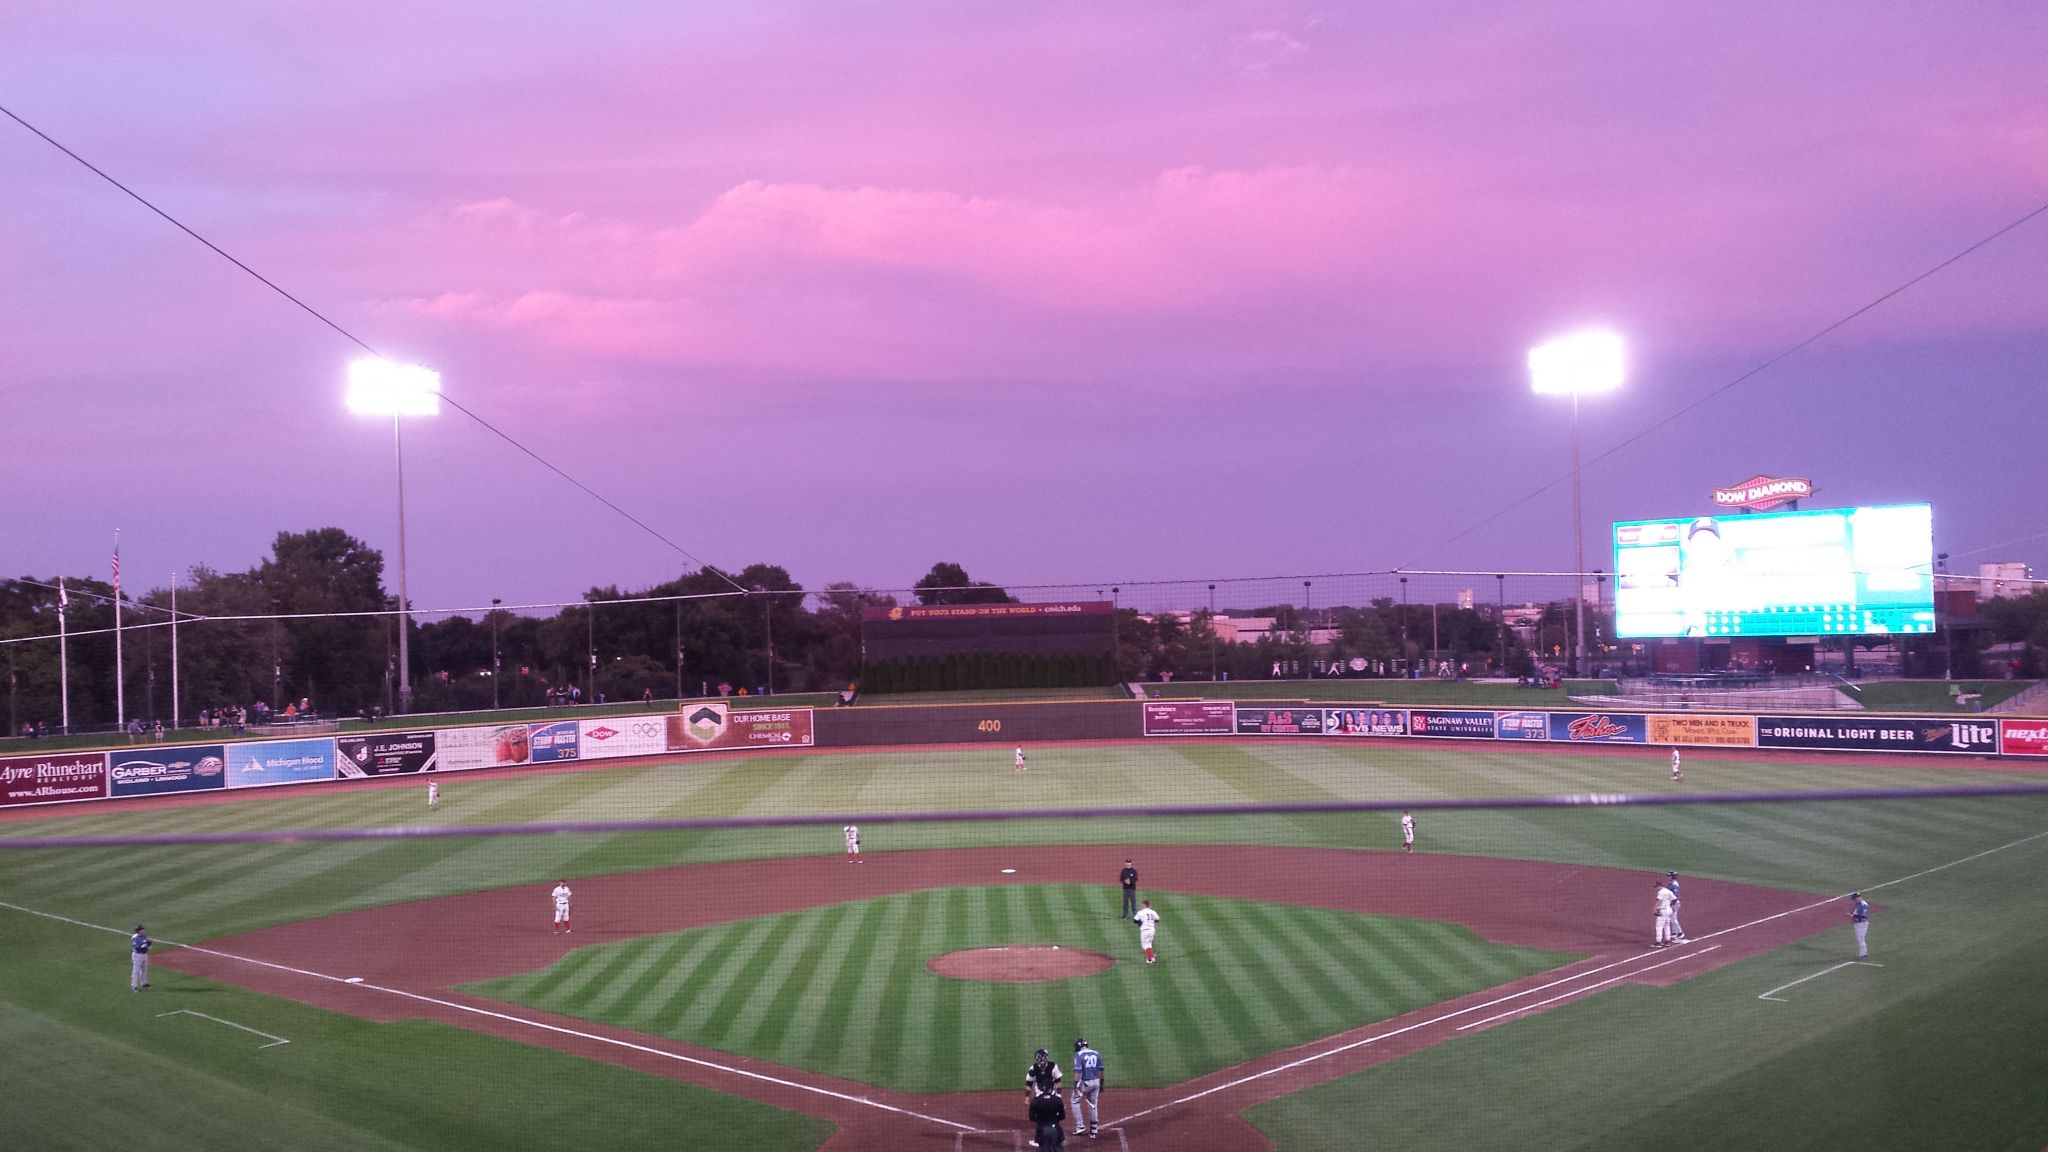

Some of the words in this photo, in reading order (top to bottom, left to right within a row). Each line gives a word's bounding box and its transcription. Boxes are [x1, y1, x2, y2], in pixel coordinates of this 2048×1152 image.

[1717, 491, 1746, 503] DOW
[1749, 482, 1807, 500] DIAMOND
[951, 608, 976, 616] STAMP
[991, 607, 1007, 615] THE
[1044, 605, 1081, 614] cmich.edu
[733, 714, 749, 723] OUR
[750, 714, 771, 722] HOME
[772, 713, 791, 721] BASE
[1267, 711, 1293, 725] A&S
[1427, 716, 1463, 725] SAGINAW
[1464, 718, 1494, 726] VALLEY
[978, 719, 1001, 731] 400
[1371, 725, 1404, 733] NEWS
[1568, 714, 1628, 740] Fisher
[592, 730, 614, 738] DOW
[749, 732, 781, 740] CHEMICAL
[1525, 729, 1545, 738] 373
[1774, 728, 1834, 738] ORIGINAL
[1838, 729, 1876, 739] LIGHT
[1880, 730, 1914, 740] BEER
[1950, 723, 1993, 748] Lite
[374, 744, 387, 752] J.E.
[388, 742, 423, 751] JOHNSON
[558, 748, 577, 758] 375
[266, 758, 301, 768] Michigan
[302, 754, 324, 765] Blood
[0, 766, 33, 784] Ayre
[37, 760, 104, 778] Rhinehart
[111, 766, 167, 779] GARBER
[37, 774, 97, 783] REALTORS
[8, 785, 99, 798] www.ARhouse.com
[1084, 1054, 1098, 1068] 20
